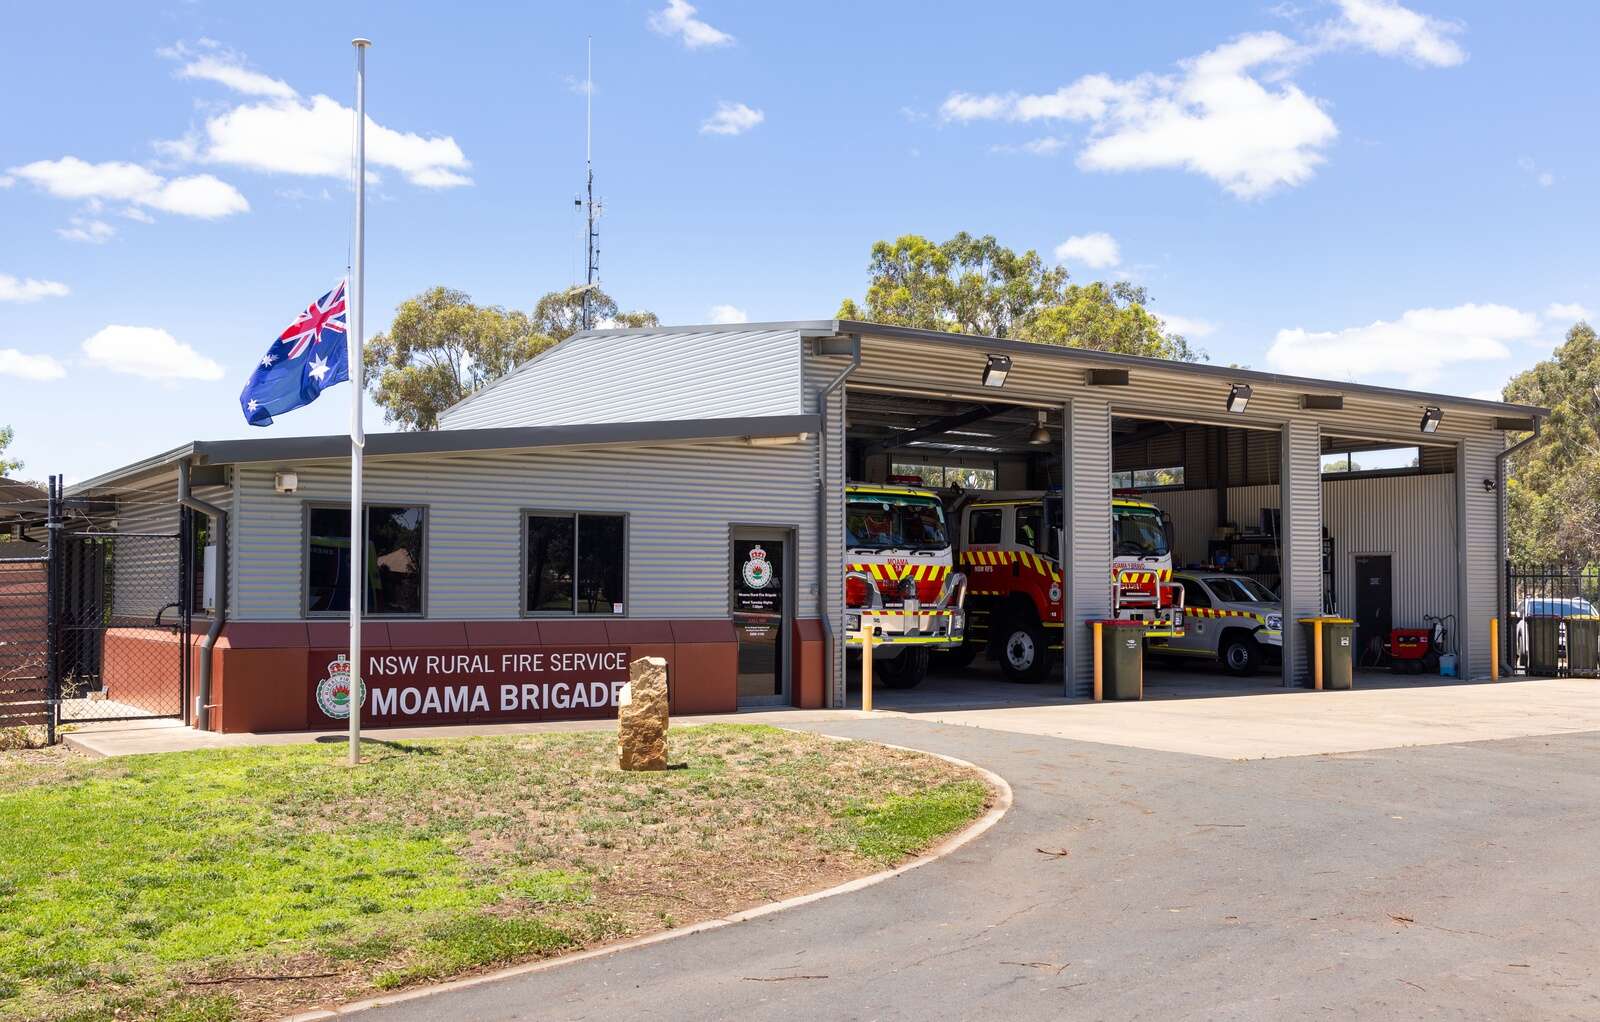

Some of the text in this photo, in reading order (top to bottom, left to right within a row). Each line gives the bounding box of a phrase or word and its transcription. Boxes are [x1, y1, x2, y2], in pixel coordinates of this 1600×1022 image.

[369, 652, 627, 675] NSW RURAL FIRE SERVICE
[371, 681, 628, 716] MOAMA BRIGADE
